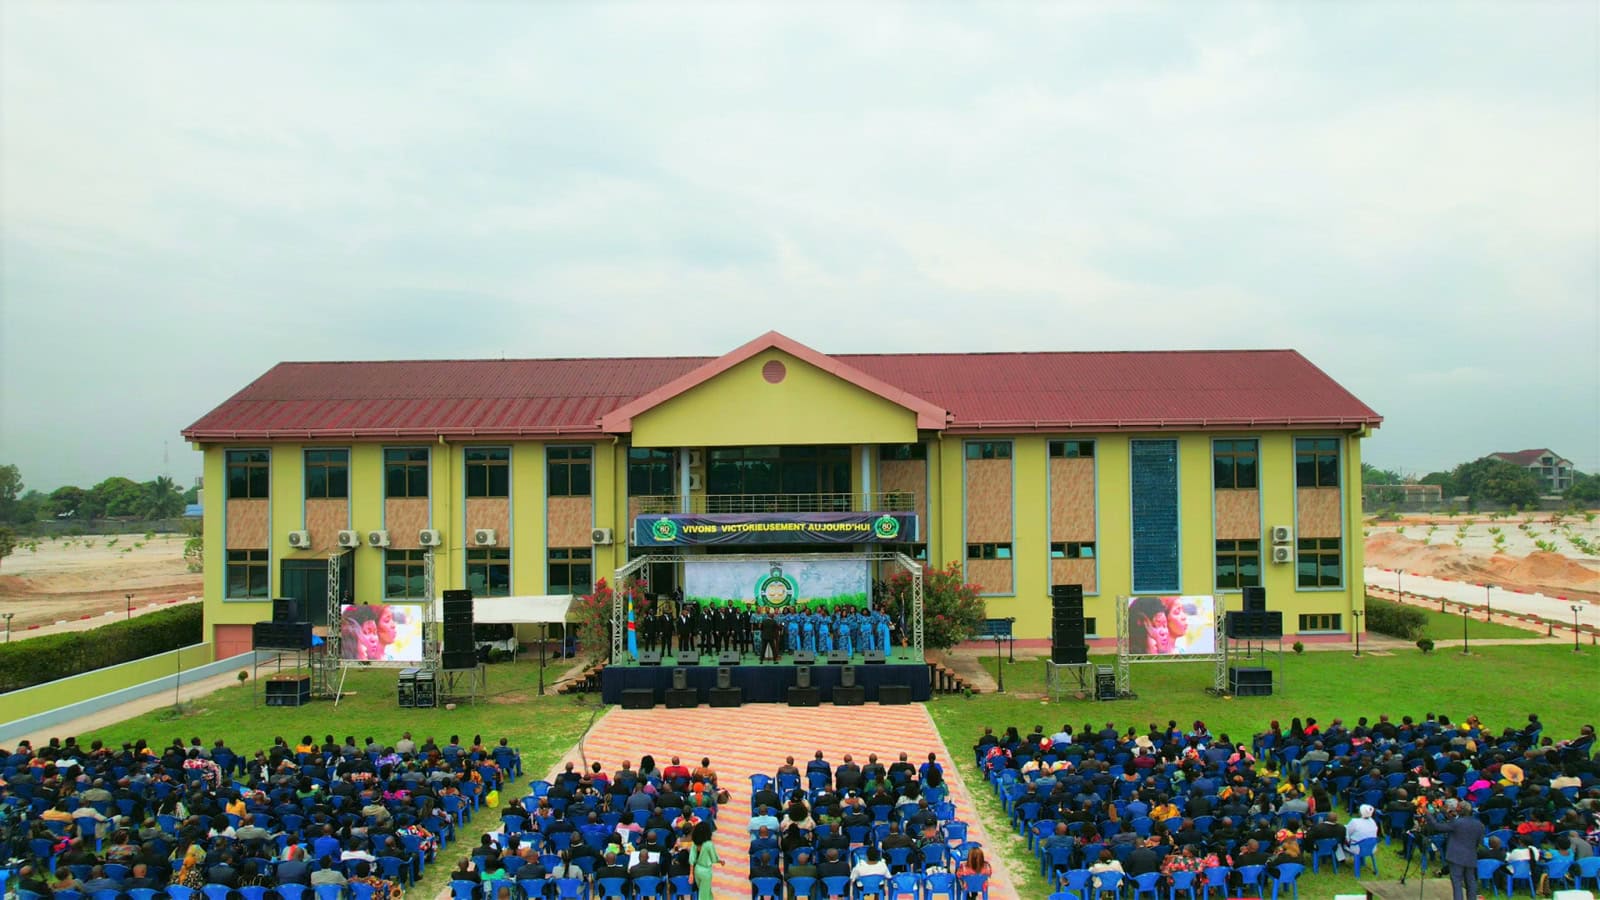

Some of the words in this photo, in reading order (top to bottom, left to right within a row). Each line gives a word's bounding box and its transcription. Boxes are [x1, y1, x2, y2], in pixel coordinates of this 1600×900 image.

[682, 525, 717, 533] VIVONS
[721, 523, 806, 532] VICTORIEUSEMENT
[808, 523, 871, 531] AUJOURD'HUI
